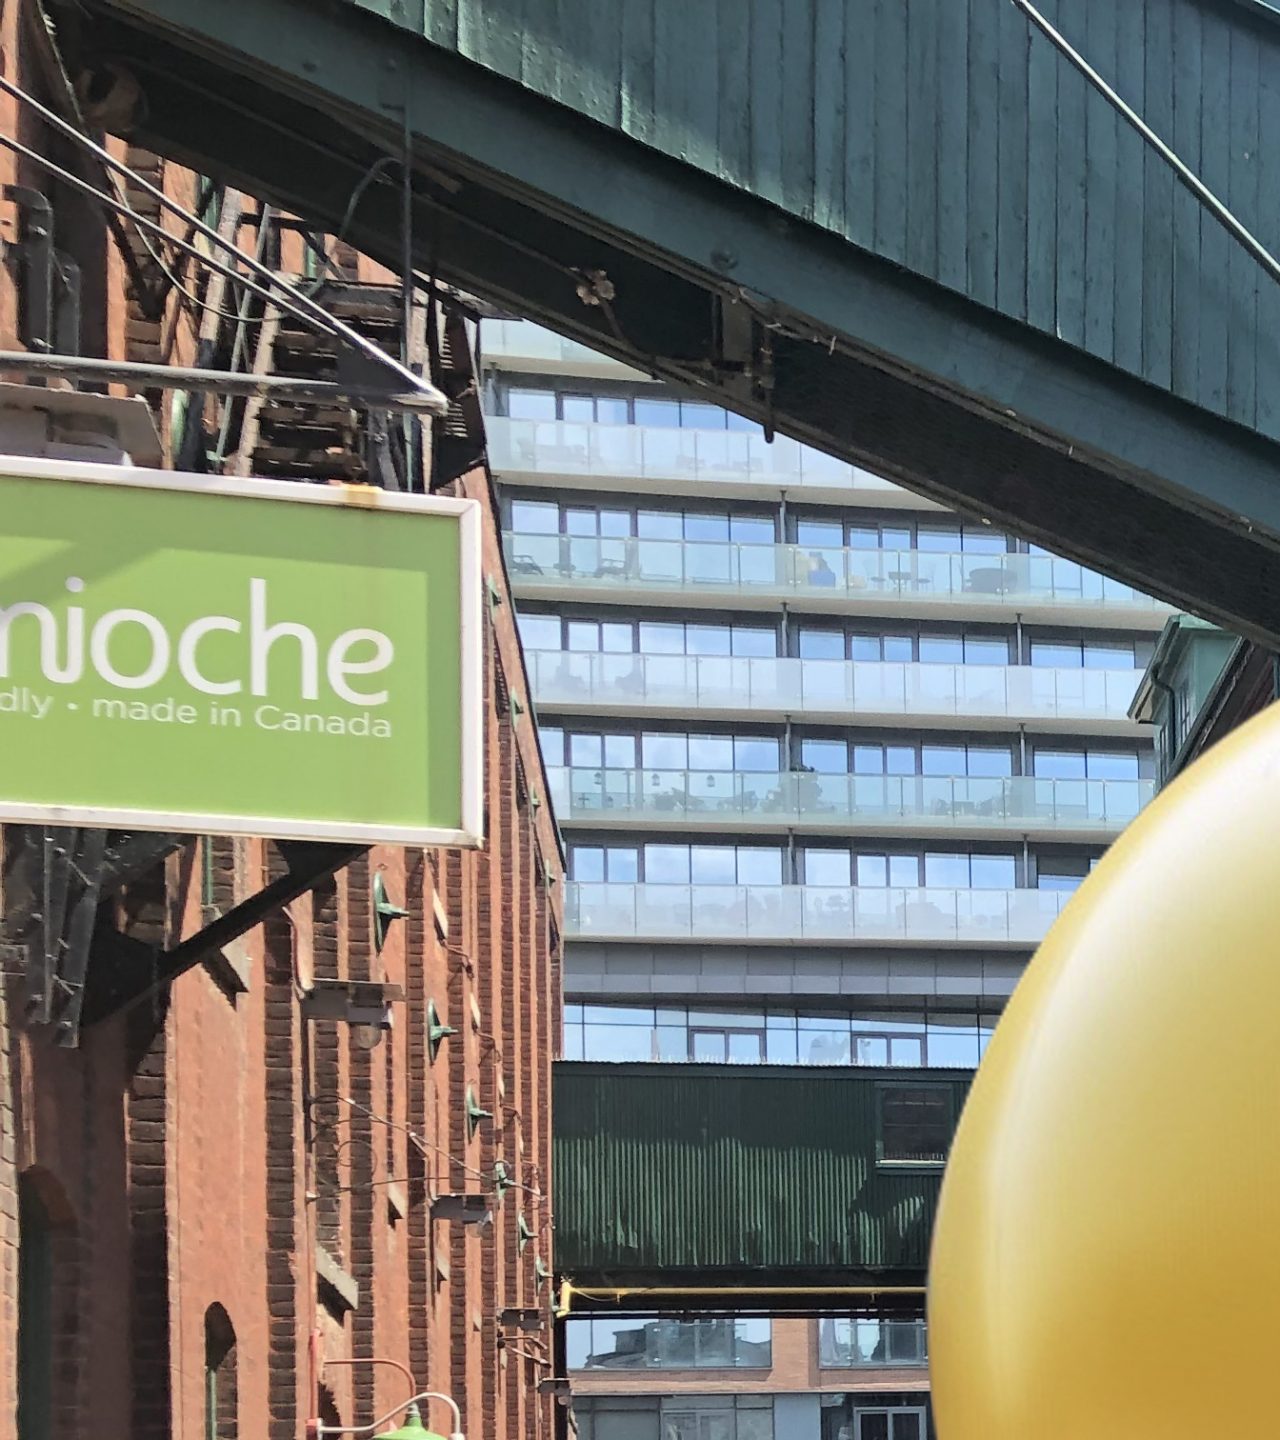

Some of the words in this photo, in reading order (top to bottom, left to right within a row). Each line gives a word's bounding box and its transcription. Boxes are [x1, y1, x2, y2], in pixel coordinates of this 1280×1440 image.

[92, 698, 198, 725] made
[210, 702, 242, 727] in
[254, 705, 392, 738] Canada
